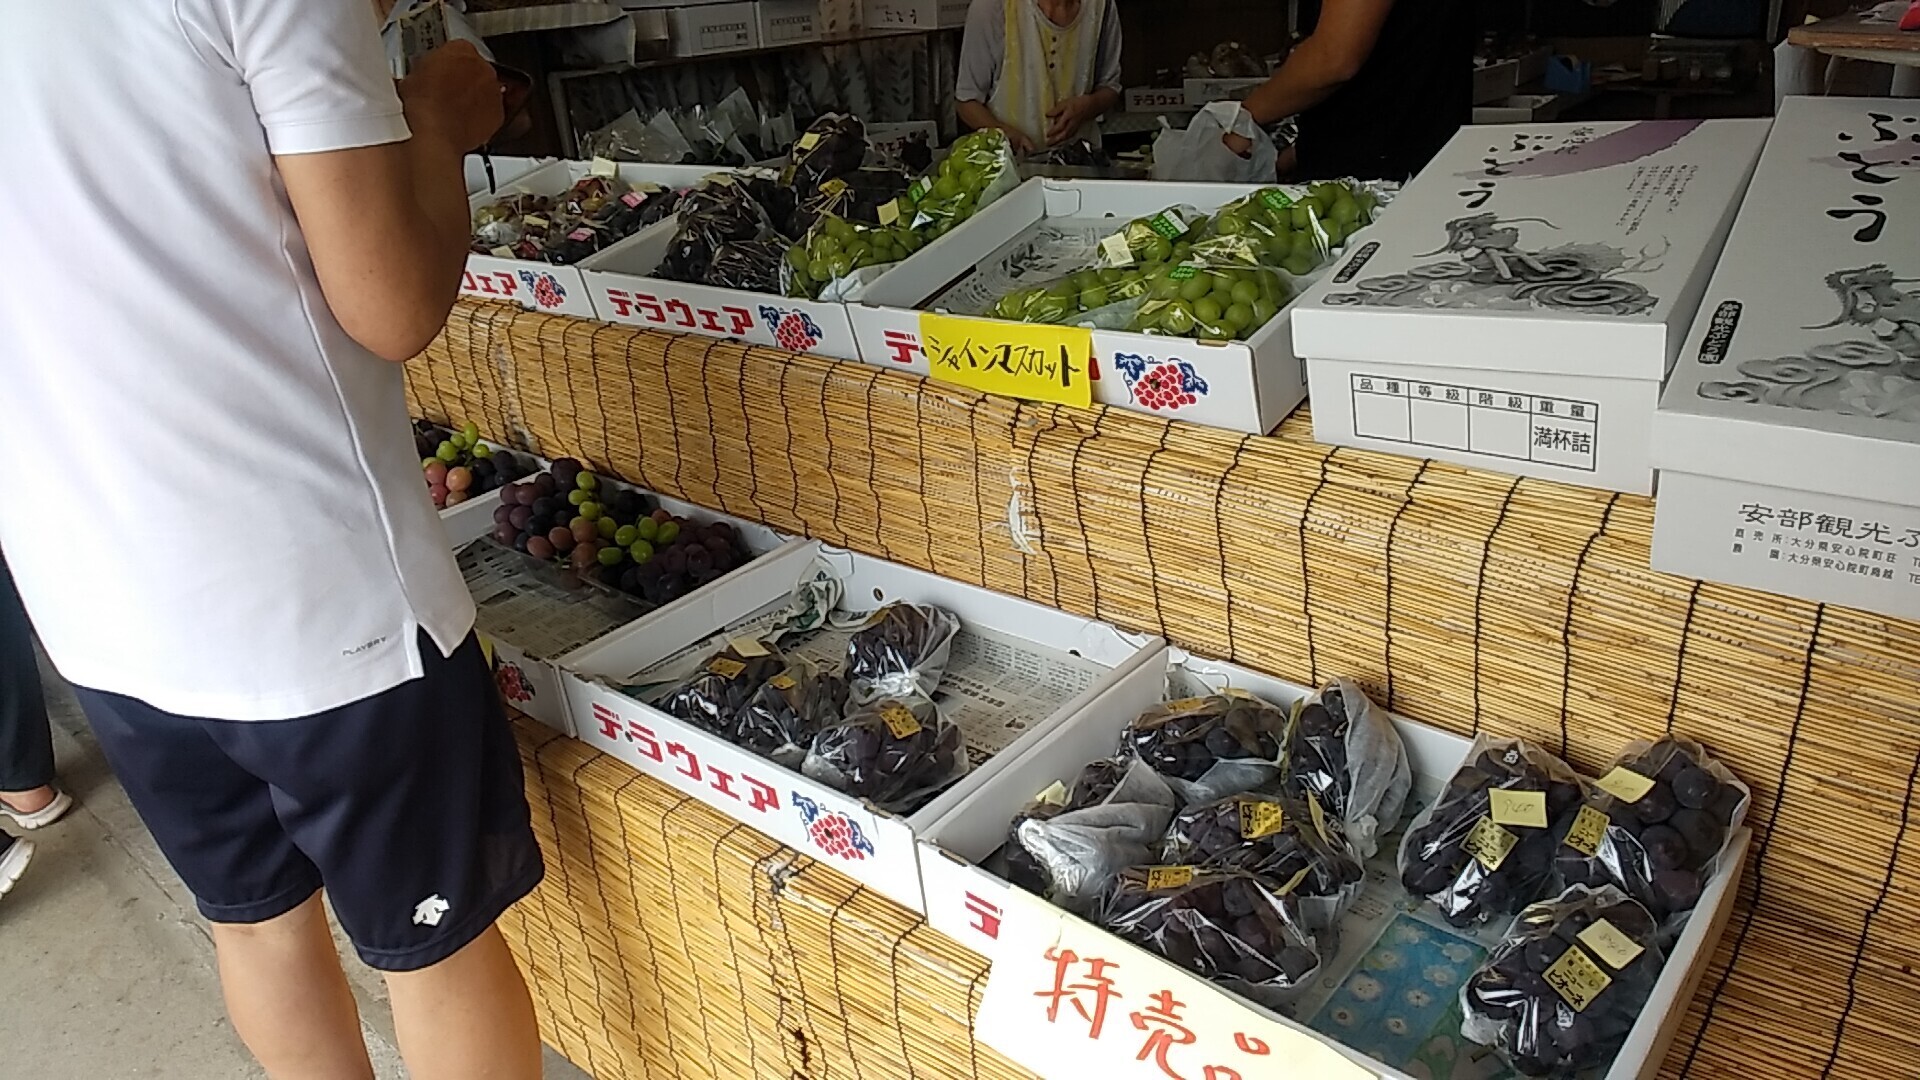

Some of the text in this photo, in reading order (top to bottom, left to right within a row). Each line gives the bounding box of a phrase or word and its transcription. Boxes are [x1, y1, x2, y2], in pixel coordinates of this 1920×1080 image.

[606, 288, 755, 335] デラウェア
[928, 335, 1080, 387] シャインマスカット
[1533, 425, 1592, 454] 満杯詰
[592, 703, 780, 813] デラウェア
